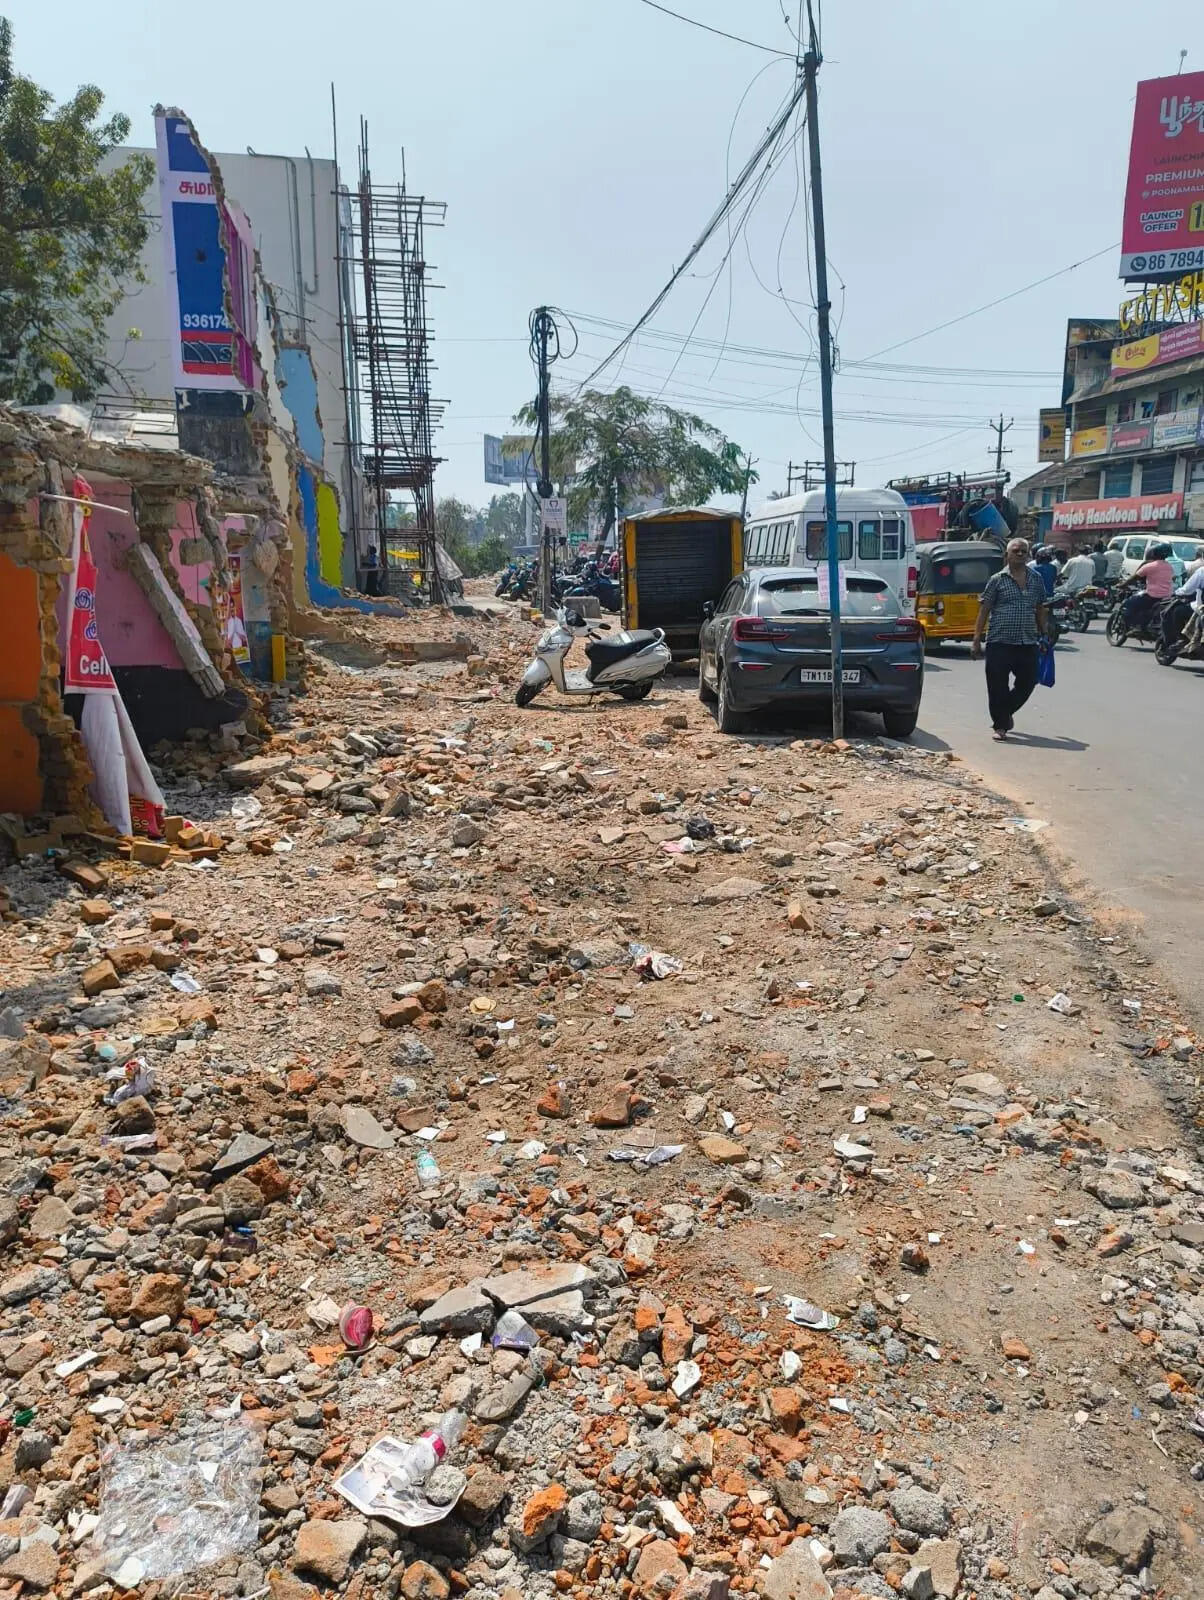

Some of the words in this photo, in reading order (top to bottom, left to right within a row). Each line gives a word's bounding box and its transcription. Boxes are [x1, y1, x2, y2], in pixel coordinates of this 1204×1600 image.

[1141, 209, 1184, 222] LAUNCH
[1144, 222, 1178, 232] OFFER
[1148, 253, 1166, 270] 86
[1119, 282, 1175, 332] CCTV
[1053, 508, 1085, 529] Punjab
[1087, 506, 1137, 525] Handloom
[1141, 502, 1178, 521] World
